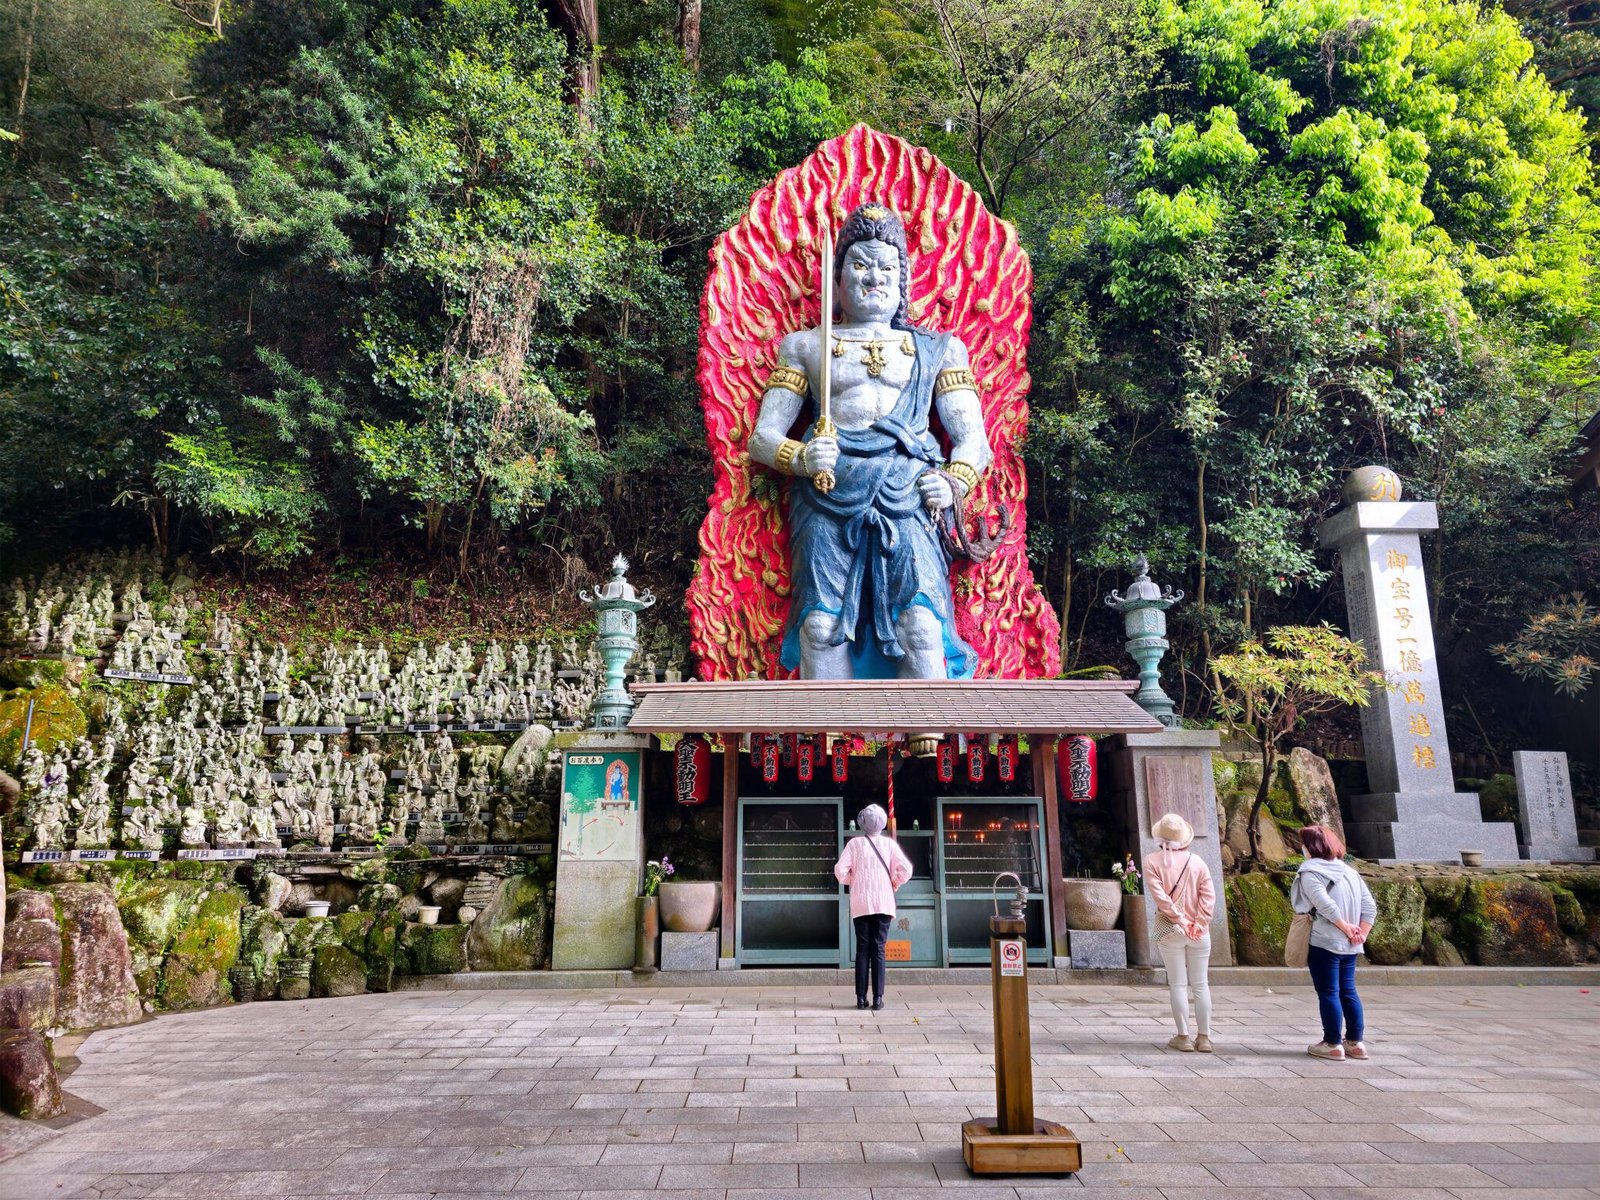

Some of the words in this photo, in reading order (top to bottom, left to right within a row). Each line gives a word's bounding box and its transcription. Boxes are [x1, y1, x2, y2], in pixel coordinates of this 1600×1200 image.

[570, 756, 603, 764] お百度参り
[677, 737, 698, 803] 大聖不動明王
[765, 746, 776, 779] 不動尊
[800, 747, 811, 779] 不動尊
[835, 746, 845, 778] 不動尊
[942, 746, 953, 778] 不動尊
[970, 746, 982, 779] 不動尊
[999, 746, 1011, 778] 不動尊
[1068, 738, 1092, 800] 大聖不動明王
